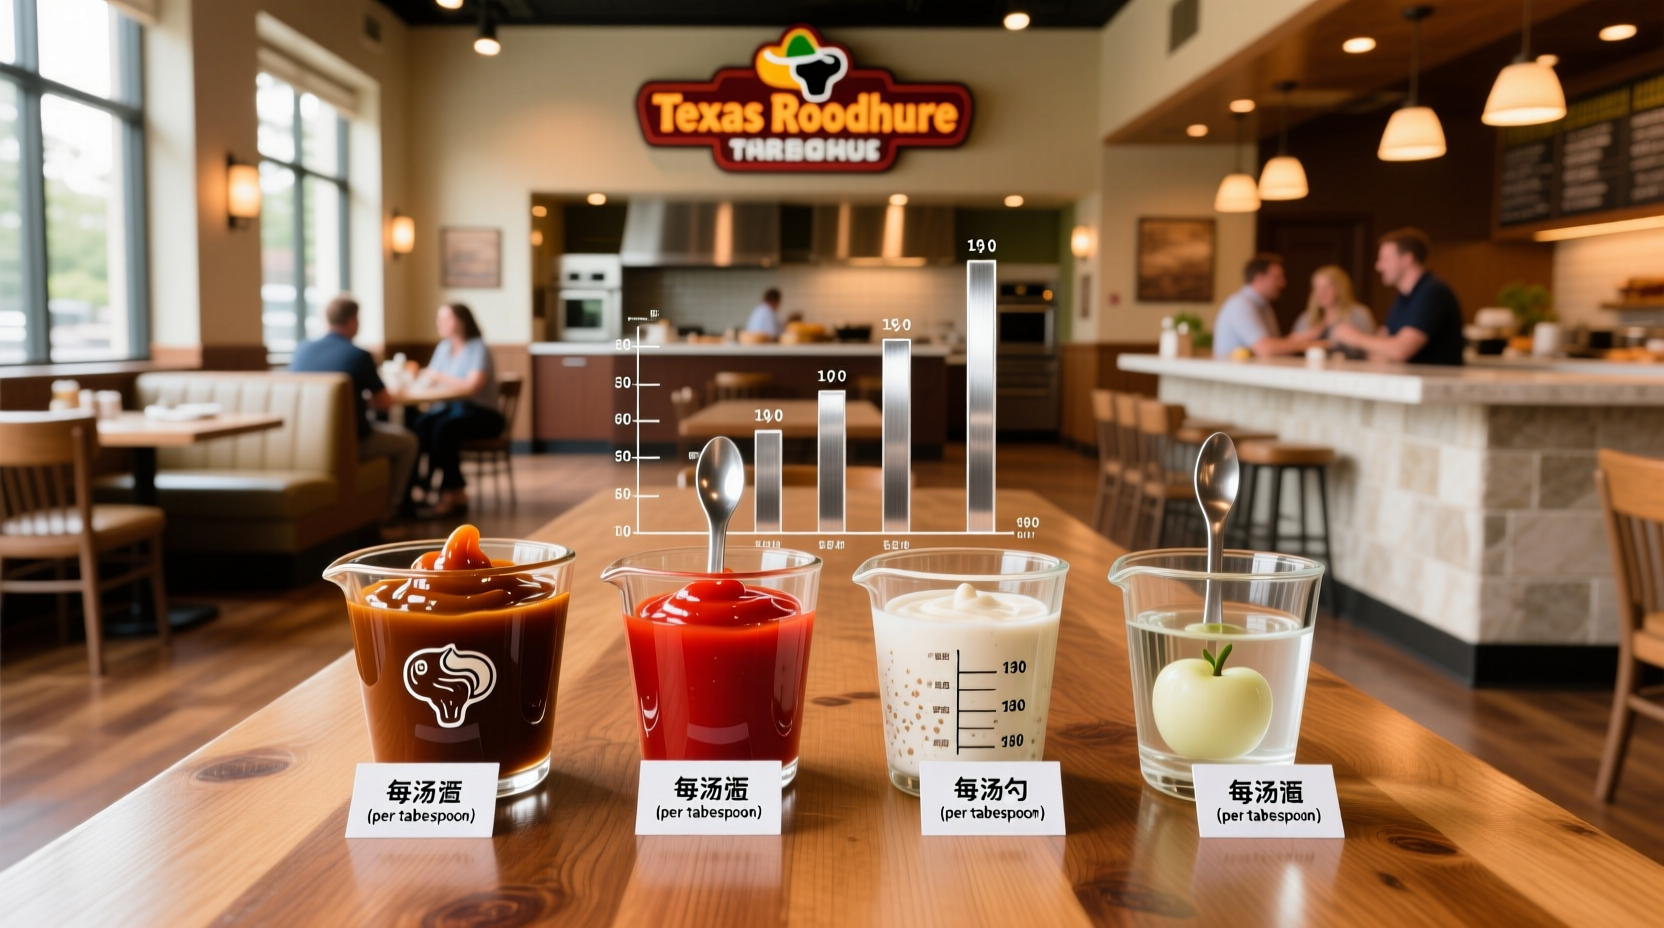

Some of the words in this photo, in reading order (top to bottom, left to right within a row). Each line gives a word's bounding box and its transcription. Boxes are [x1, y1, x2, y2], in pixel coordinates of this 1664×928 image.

[652, 92, 764, 134] Texas
[770, 92, 959, 134] Roodhure
[954, 776, 1027, 802] 每汤勺
[367, 808, 396, 825] (per
[399, 808, 475, 825] tabespoon)
[656, 805, 683, 822] (per
[687, 805, 762, 822] tabespoon)
[940, 805, 967, 822] (per
[1217, 807, 1244, 825] (per
